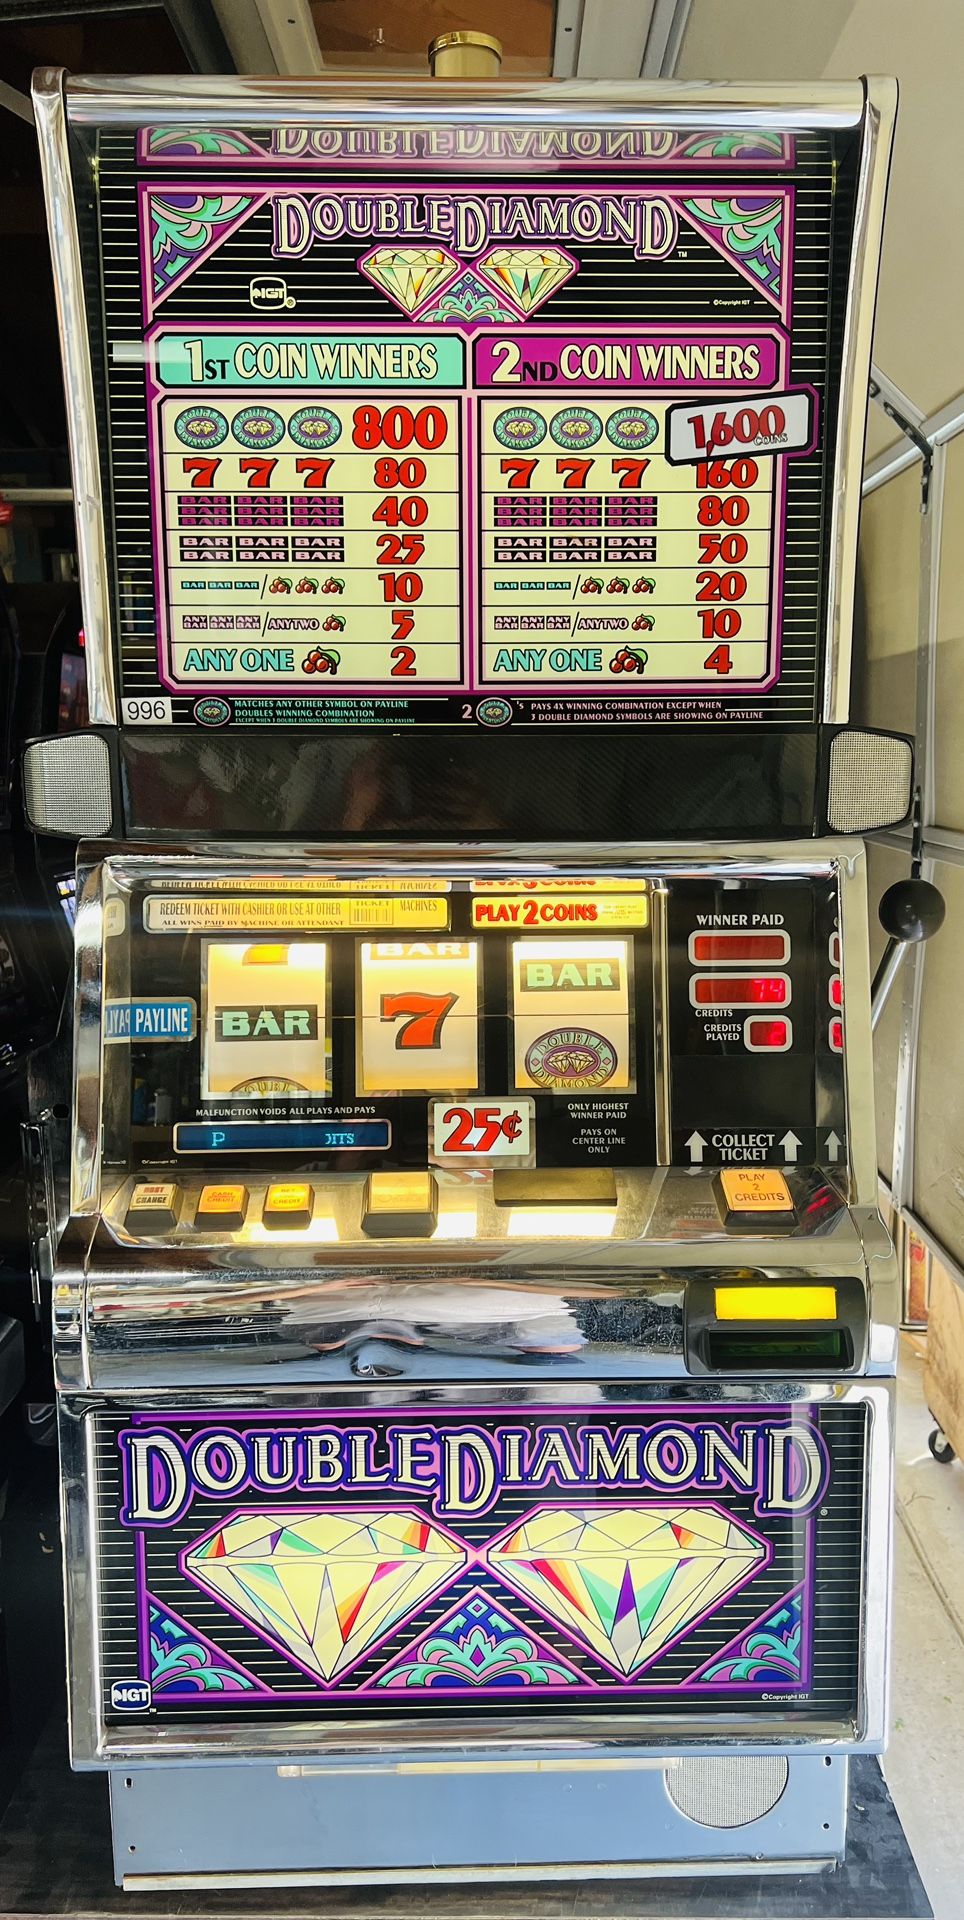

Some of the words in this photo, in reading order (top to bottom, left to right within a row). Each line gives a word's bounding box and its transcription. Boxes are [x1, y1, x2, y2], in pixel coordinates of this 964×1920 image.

[261, 287, 285, 299] IGT
[184, 339, 230, 382] 1ST
[234, 342, 307, 379] COIN
[311, 343, 439, 380] WINNERS
[491, 340, 557, 383] 2ND
[559, 344, 631, 381] COIN
[636, 344, 761, 381] WINNERS
[352, 405, 448, 450] 800
[687, 404, 786, 457] 1,600
[753, 432, 788, 447] COINS
[182, 457, 223, 488] 7
[239, 457, 279, 488] 7
[295, 457, 335, 488] 7
[374, 457, 427, 488] 80
[500, 458, 540, 488] 7
[556, 458, 596, 488] 7
[612, 458, 651, 488] 7
[692, 457, 759, 489] 160
[372, 495, 429, 527] 40
[697, 495, 749, 526] 80
[183, 537, 229, 546] BAR
[239, 537, 285, 546] BAR
[295, 537, 341, 546] BAR
[376, 534, 425, 564] 25
[498, 538, 543, 546] BAR
[553, 538, 598, 546] BAR
[608, 538, 653, 546] BAR
[697, 533, 748, 564] 50
[378, 571, 423, 602] 10
[695, 570, 748, 601] 20
[391, 609, 415, 640] 5
[697, 608, 742, 638] 10
[183, 648, 238, 672] ANY
[239, 648, 294, 672] ONE
[390, 645, 417, 676] 2
[493, 648, 547, 672] ANY
[549, 648, 602, 672] ONE
[703, 644, 733, 674] 4
[128, 701, 166, 720] 996
[234, 700, 274, 708] MATCHES
[276, 700, 293, 708] ANY
[295, 700, 323, 708] OTHER
[325, 700, 358, 708] SYMBOL
[360, 700, 373, 708] ON
[375, 700, 409, 708] PAYLINE
[461, 704, 472, 719] 2
[605, 702, 665, 710] COMBINATION
[160, 903, 191, 916] REDEEM
[193, 903, 220, 916] TICKET
[221, 903, 240, 916] WITH
[242, 903, 275, 916] CASHIER
[277, 903, 288, 916] OR
[290, 903, 304, 916] USE
[305, 903, 315, 916] AT
[316, 903, 341, 916] OTHER
[400, 901, 438, 913] MACHINES
[475, 904, 521, 922] PLAY
[523, 900, 539, 925] 2
[540, 903, 598, 921] COINS
[696, 914, 748, 926] WINNER
[752, 914, 785, 925] PAID
[377, 943, 462, 956] BAR
[527, 963, 613, 987] BAR
[753, 979, 783, 1000] 74
[135, 1007, 188, 1033] PAYLINE
[380, 991, 460, 1050] 7
[695, 1009, 733, 1017] CREDITS
[222, 1010, 311, 1037] BAR
[703, 1024, 742, 1032] CREDITS
[535, 1032, 607, 1055] DOUBLE
[706, 1033, 740, 1041] PLAYED
[533, 1066, 609, 1088] DIAMOND
[196, 1108, 258, 1116] MALFUNCTION
[289, 1107, 305, 1115] ALL
[354, 1106, 376, 1114] PAYS
[567, 1103, 590, 1111] ONLY
[592, 1102, 629, 1110] HIGHEST
[605, 1111, 627, 1119] PAID
[442, 1107, 523, 1152] 25¢
[572, 1137, 606, 1145] CENTER
[712, 1134, 776, 1147] COLLECT
[719, 1148, 768, 1161] TICKET
[738, 1173, 765, 1182] PLAY
[752, 1183, 760, 1191] 2
[136, 1196, 167, 1204] CHANGE
[735, 1192, 785, 1201] CREDITS
[121, 1688, 150, 1702] IGT
